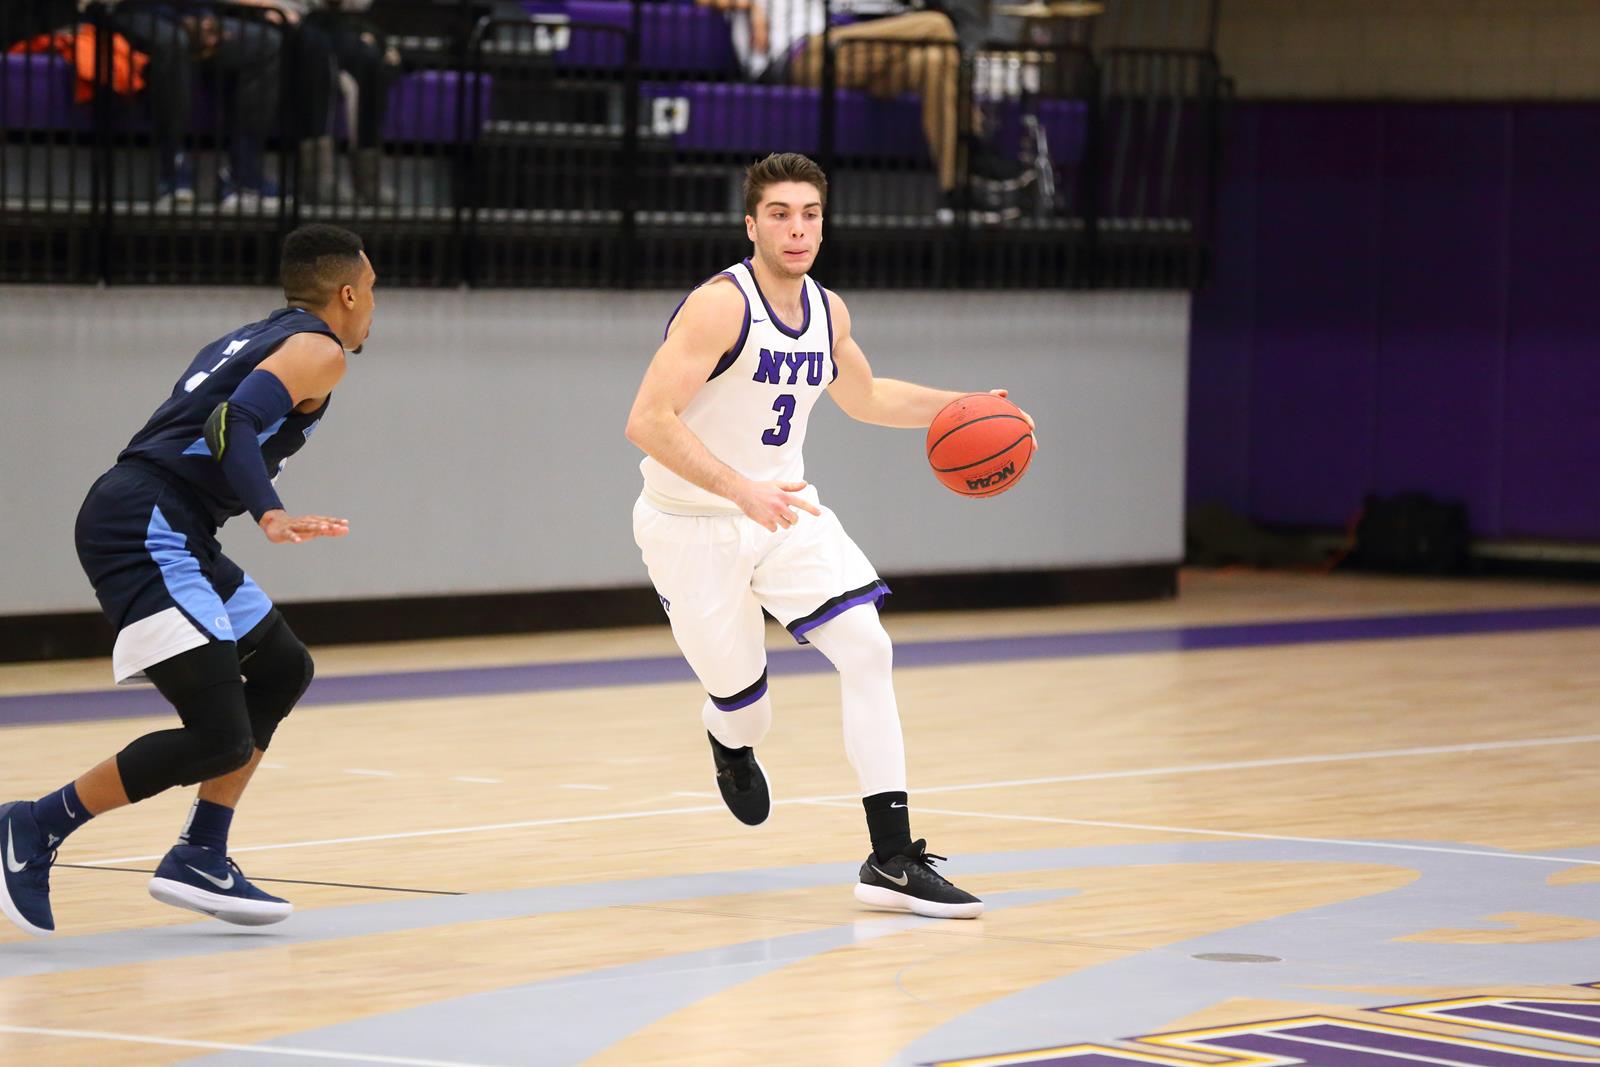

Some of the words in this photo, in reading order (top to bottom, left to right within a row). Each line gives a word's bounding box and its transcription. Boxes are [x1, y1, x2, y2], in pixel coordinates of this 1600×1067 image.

[752, 348, 824, 386] NYU
[761, 394, 796, 446] 3
[965, 461, 1016, 490] NCAA
